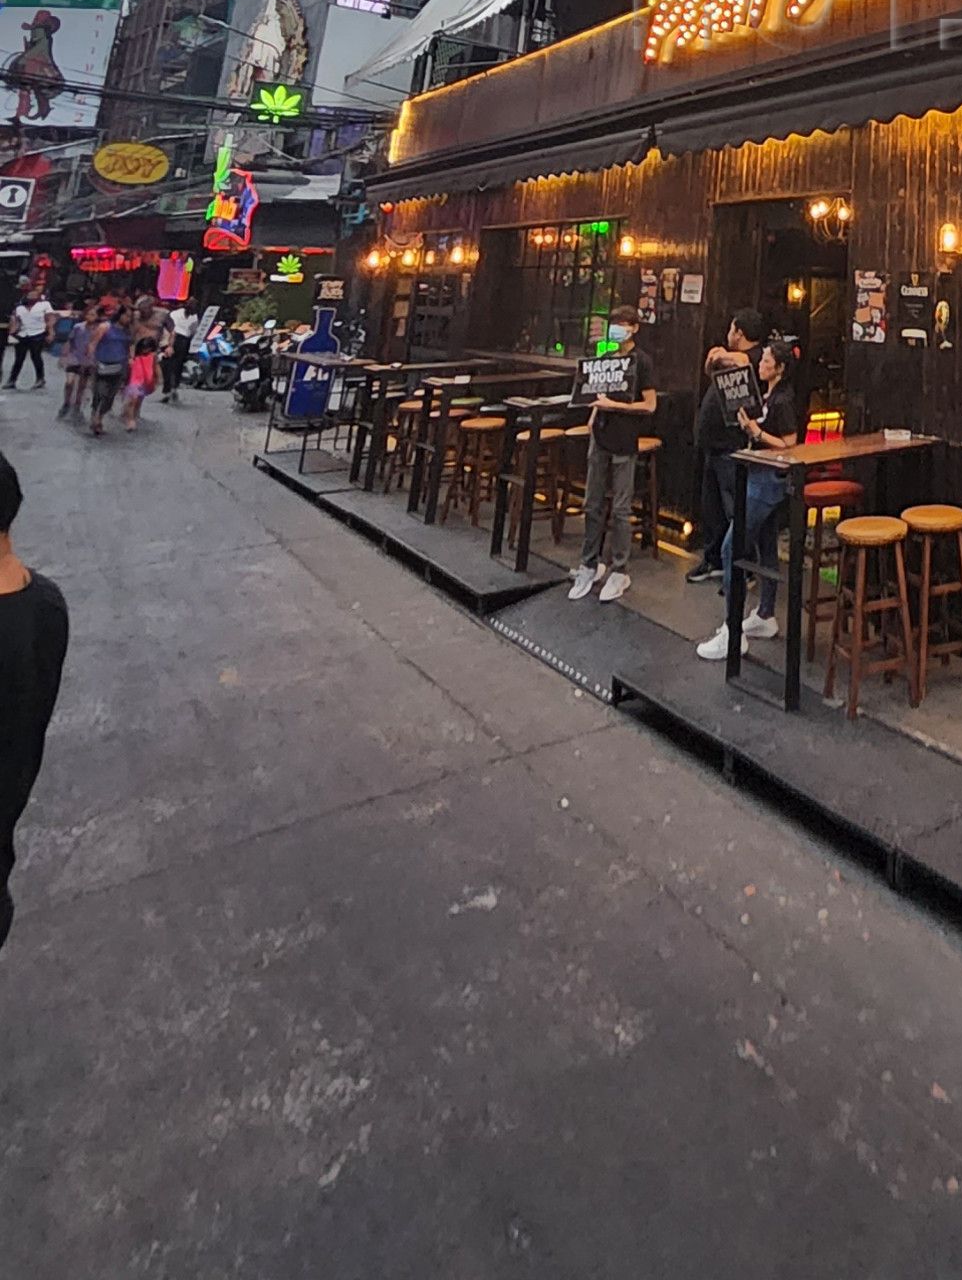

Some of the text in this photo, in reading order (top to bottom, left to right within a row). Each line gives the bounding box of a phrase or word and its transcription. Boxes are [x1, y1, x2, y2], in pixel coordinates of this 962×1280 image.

[583, 358, 631, 374] HAPPY
[589, 370, 625, 384] HOUR
[716, 369, 751, 389] HAPPY
[724, 383, 750, 399] HOUR
